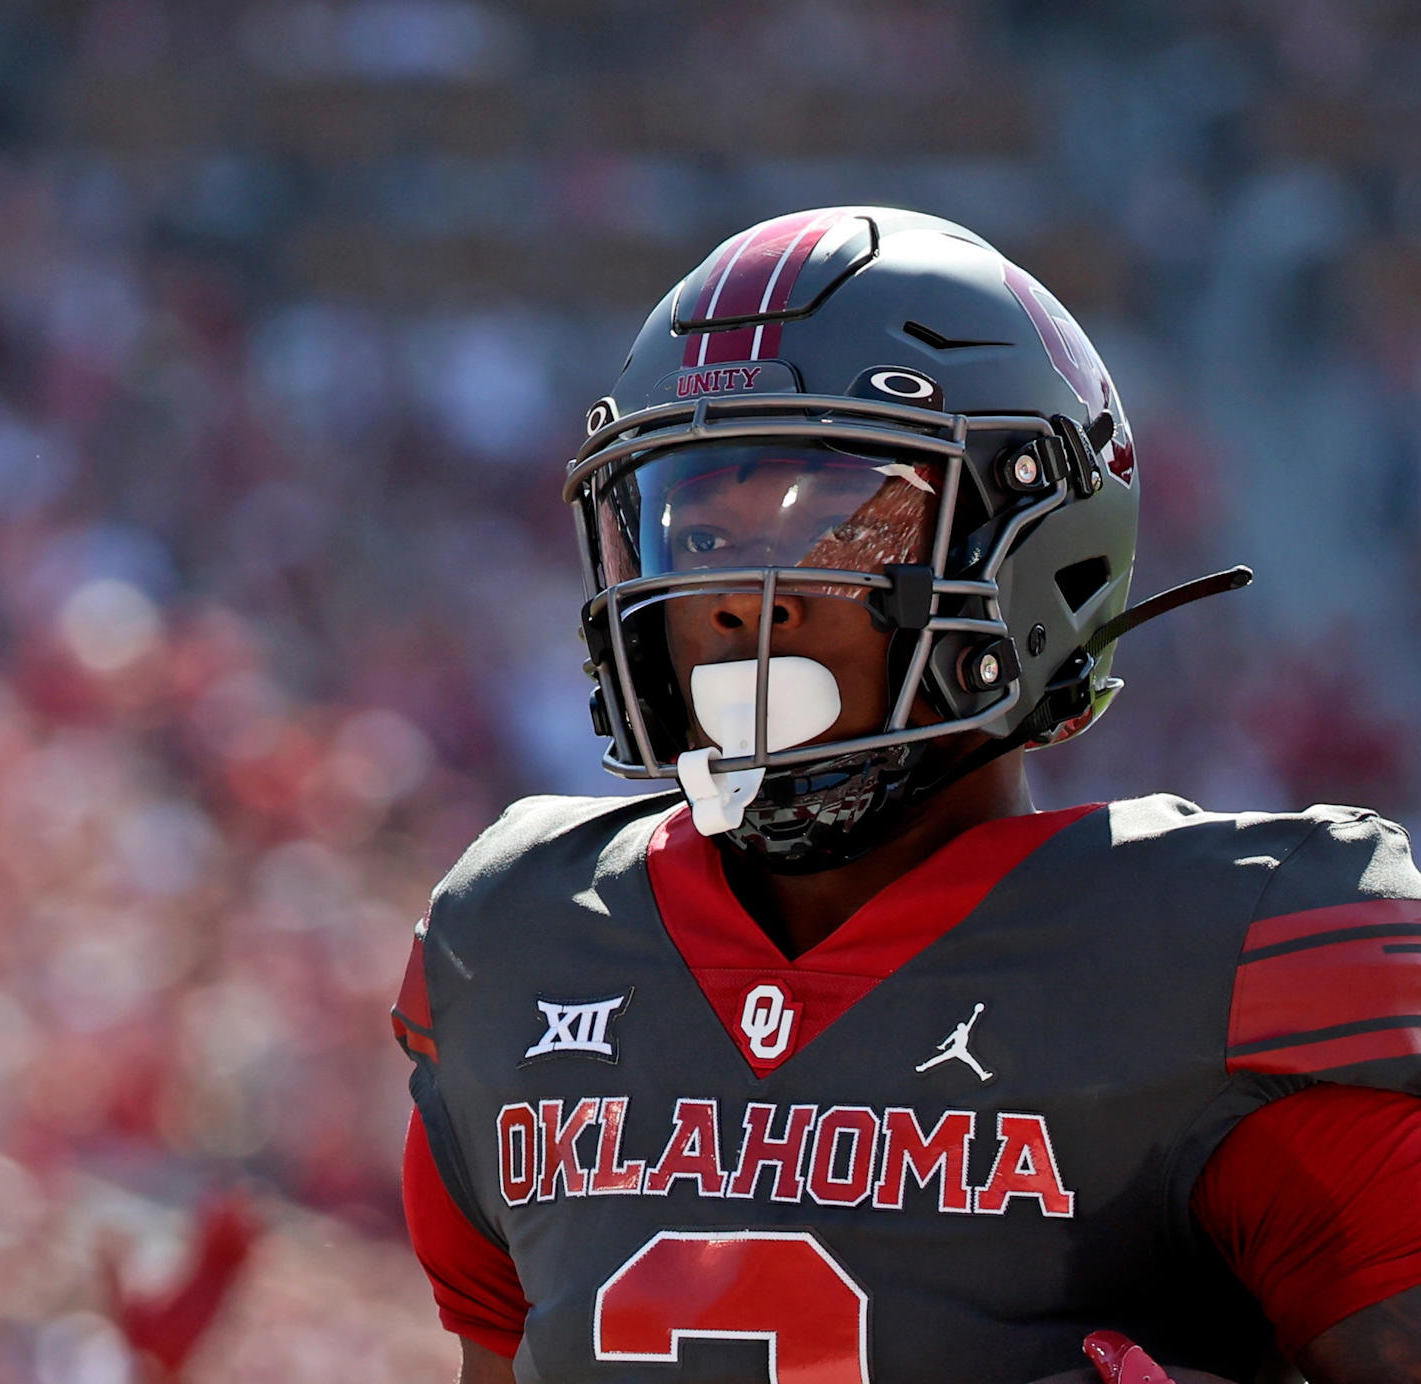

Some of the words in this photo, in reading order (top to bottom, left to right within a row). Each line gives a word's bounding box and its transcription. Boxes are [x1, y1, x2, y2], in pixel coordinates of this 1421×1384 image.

[676, 366, 762, 397] UNITY
[524, 995, 625, 1059] XII
[740, 984, 795, 1060] OU
[495, 1096, 1075, 1218] OKLAHOMA
